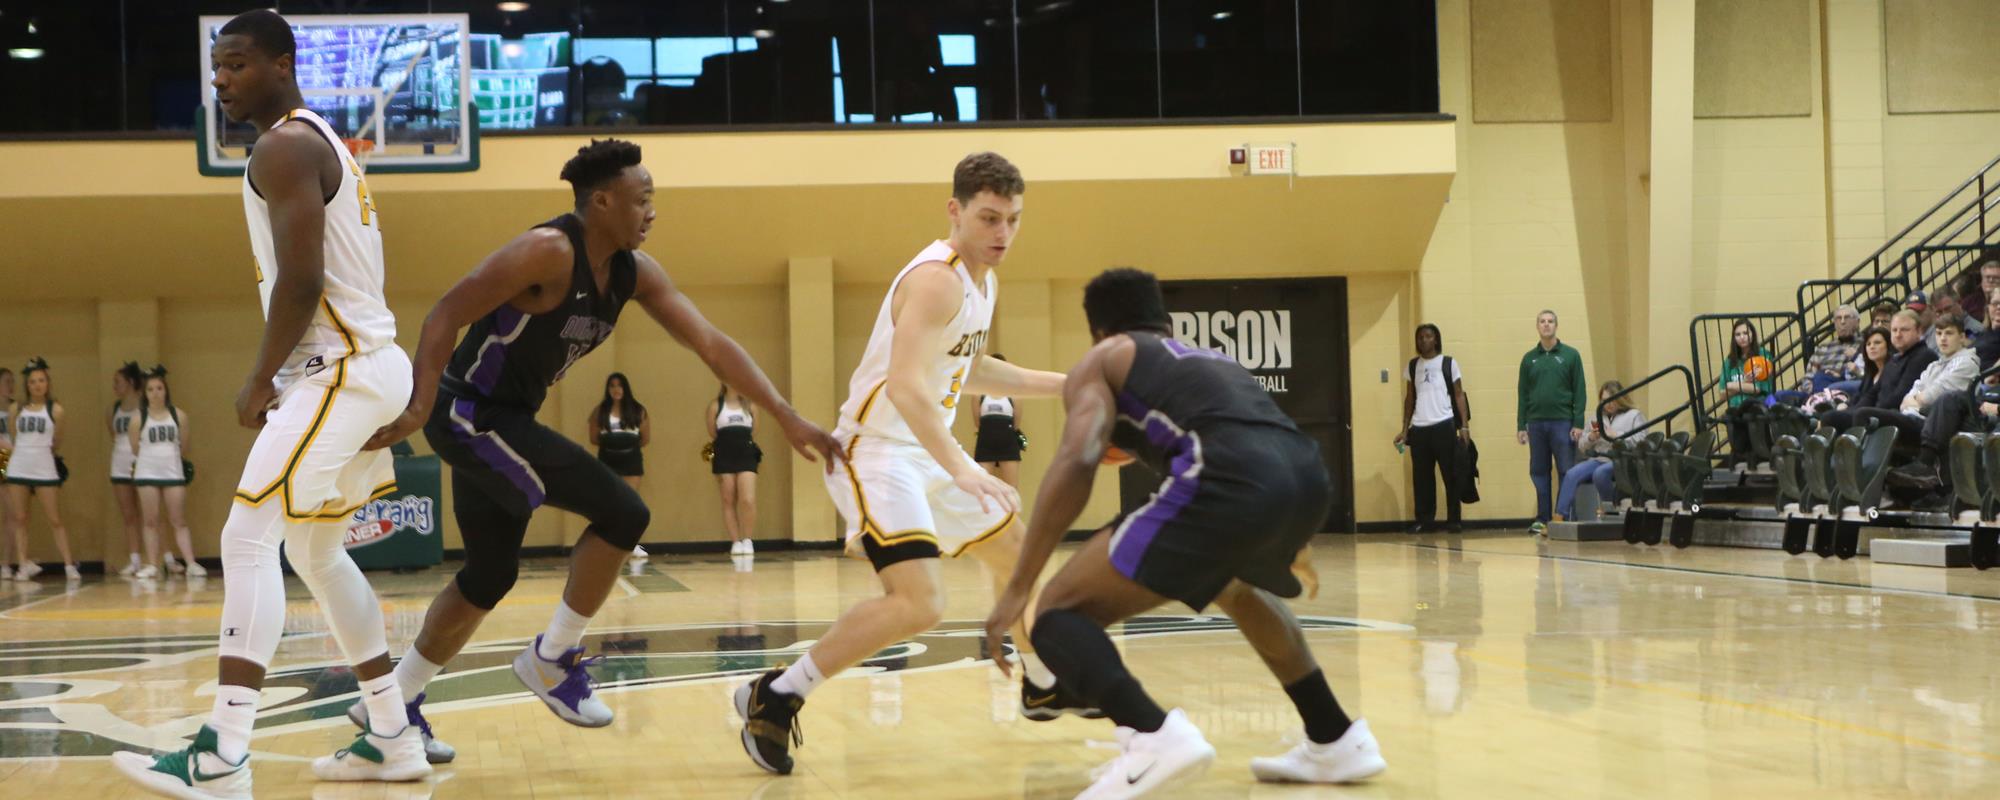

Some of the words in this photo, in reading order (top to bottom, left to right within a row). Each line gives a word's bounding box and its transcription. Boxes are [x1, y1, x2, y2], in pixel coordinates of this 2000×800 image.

[1259, 149, 1285, 169] EXIT
[1168, 310, 1292, 369] BISON
[148, 425, 175, 443] OBU
